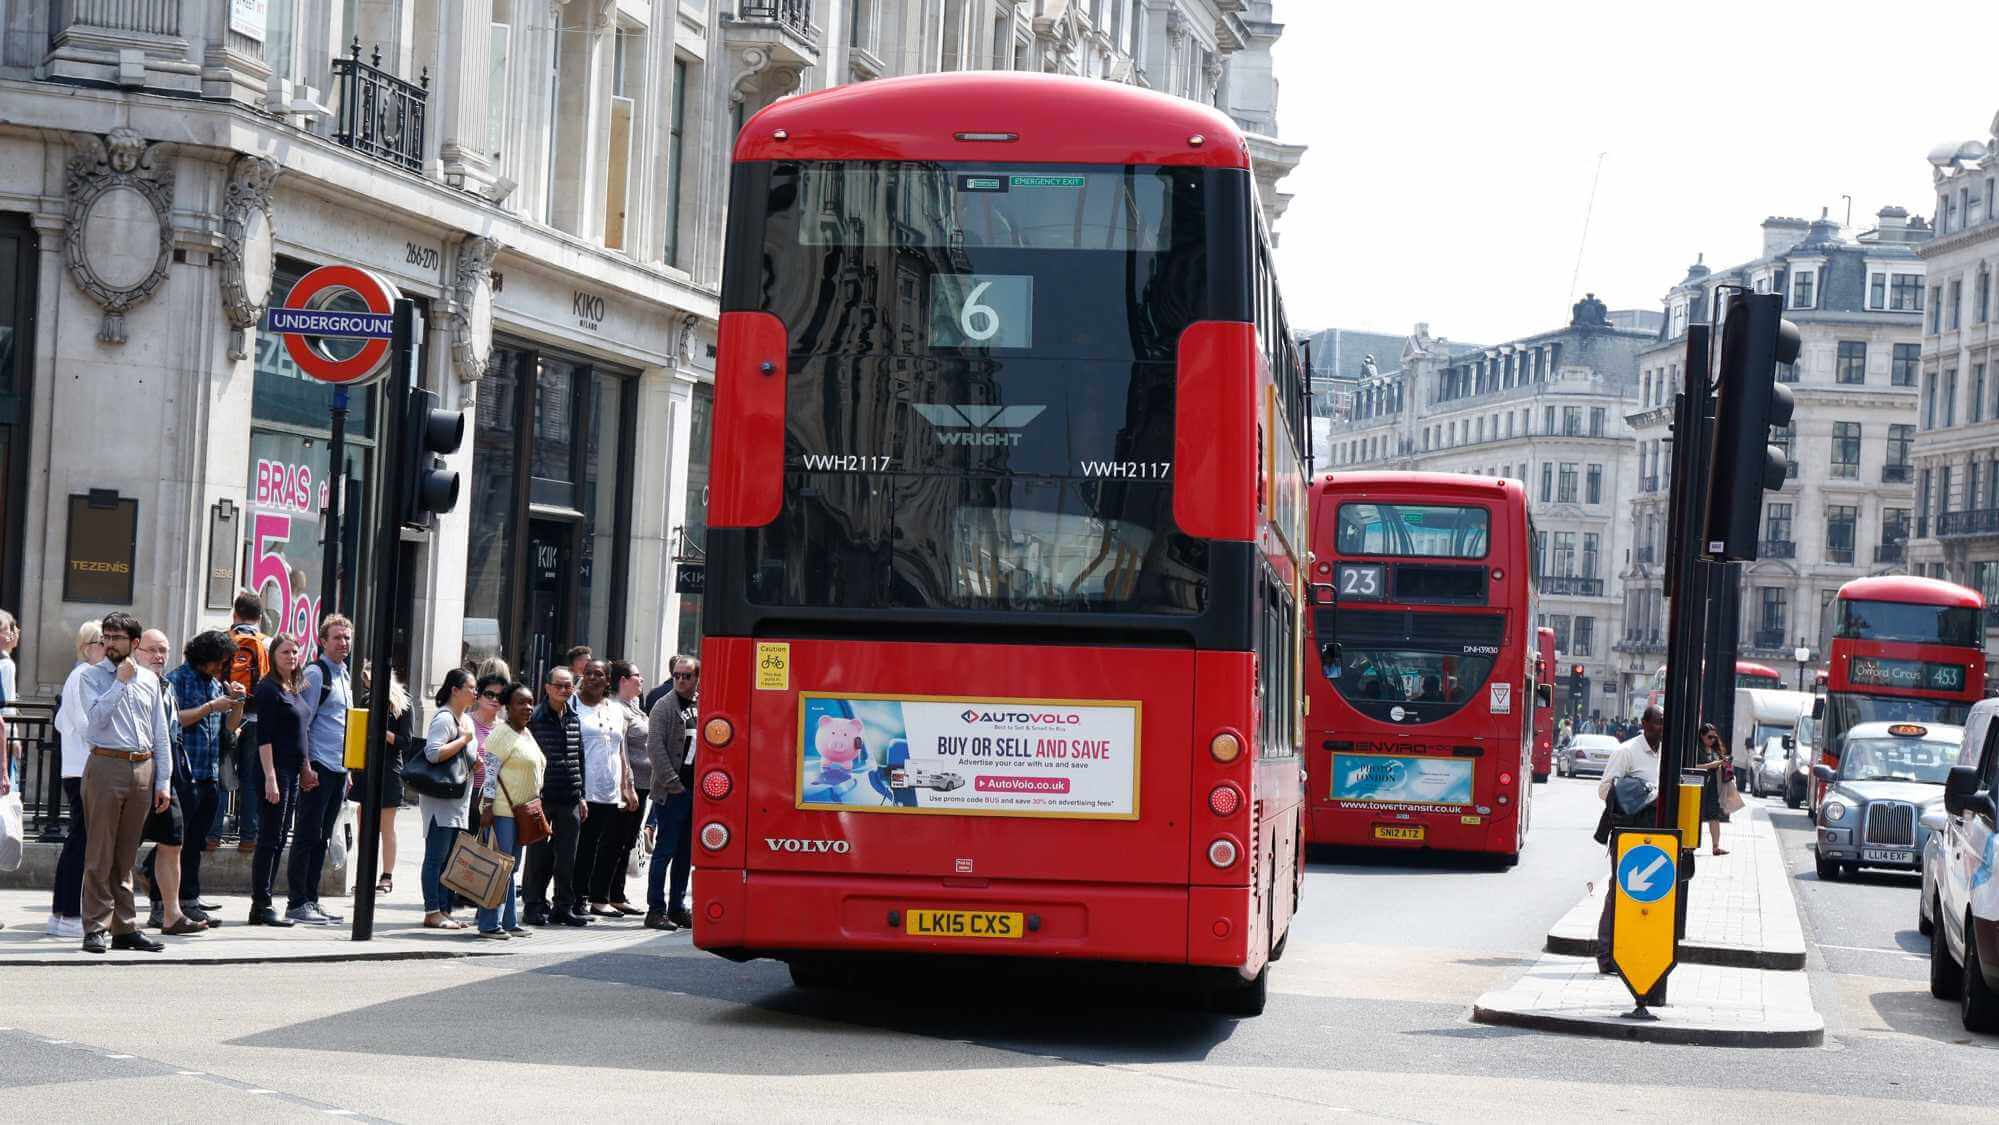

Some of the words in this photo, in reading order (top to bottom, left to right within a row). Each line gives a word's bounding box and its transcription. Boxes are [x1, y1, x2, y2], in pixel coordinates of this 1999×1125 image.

[1014, 177, 1060, 185] EMERGENCY
[1062, 178, 1080, 186] EXIT
[406, 242, 438, 271] 266-270
[573, 290, 605, 322] KIKO
[961, 281, 1000, 340] 6
[936, 431, 1022, 447] WRIGHT
[803, 454, 890, 472] VWH2117
[1080, 461, 1170, 479] VWH2117
[255, 458, 312, 514] BRAS
[1343, 569, 1376, 594] 23
[1933, 668, 1957, 686] 453
[980, 712, 1080, 724] AUTOVOLO
[938, 736, 968, 756] BUY
[972, 737, 991, 757] OR
[996, 738, 1032, 758] SELL
[1036, 739, 1067, 759] AND
[1071, 740, 1110, 760] SAVE
[1354, 741, 1426, 753] ENVIRO
[959, 758, 993, 767] Advertise
[1027, 760, 1042, 768] with
[987, 779, 1065, 791] AutoVolo.co.uk
[1058, 799, 1096, 807] advertising
[1339, 800, 1462, 814] www.towertransit.co.uk
[764, 838, 849, 853] VOLVO
[919, 912, 964, 933] LK15
[971, 914, 1011, 935] CXS
